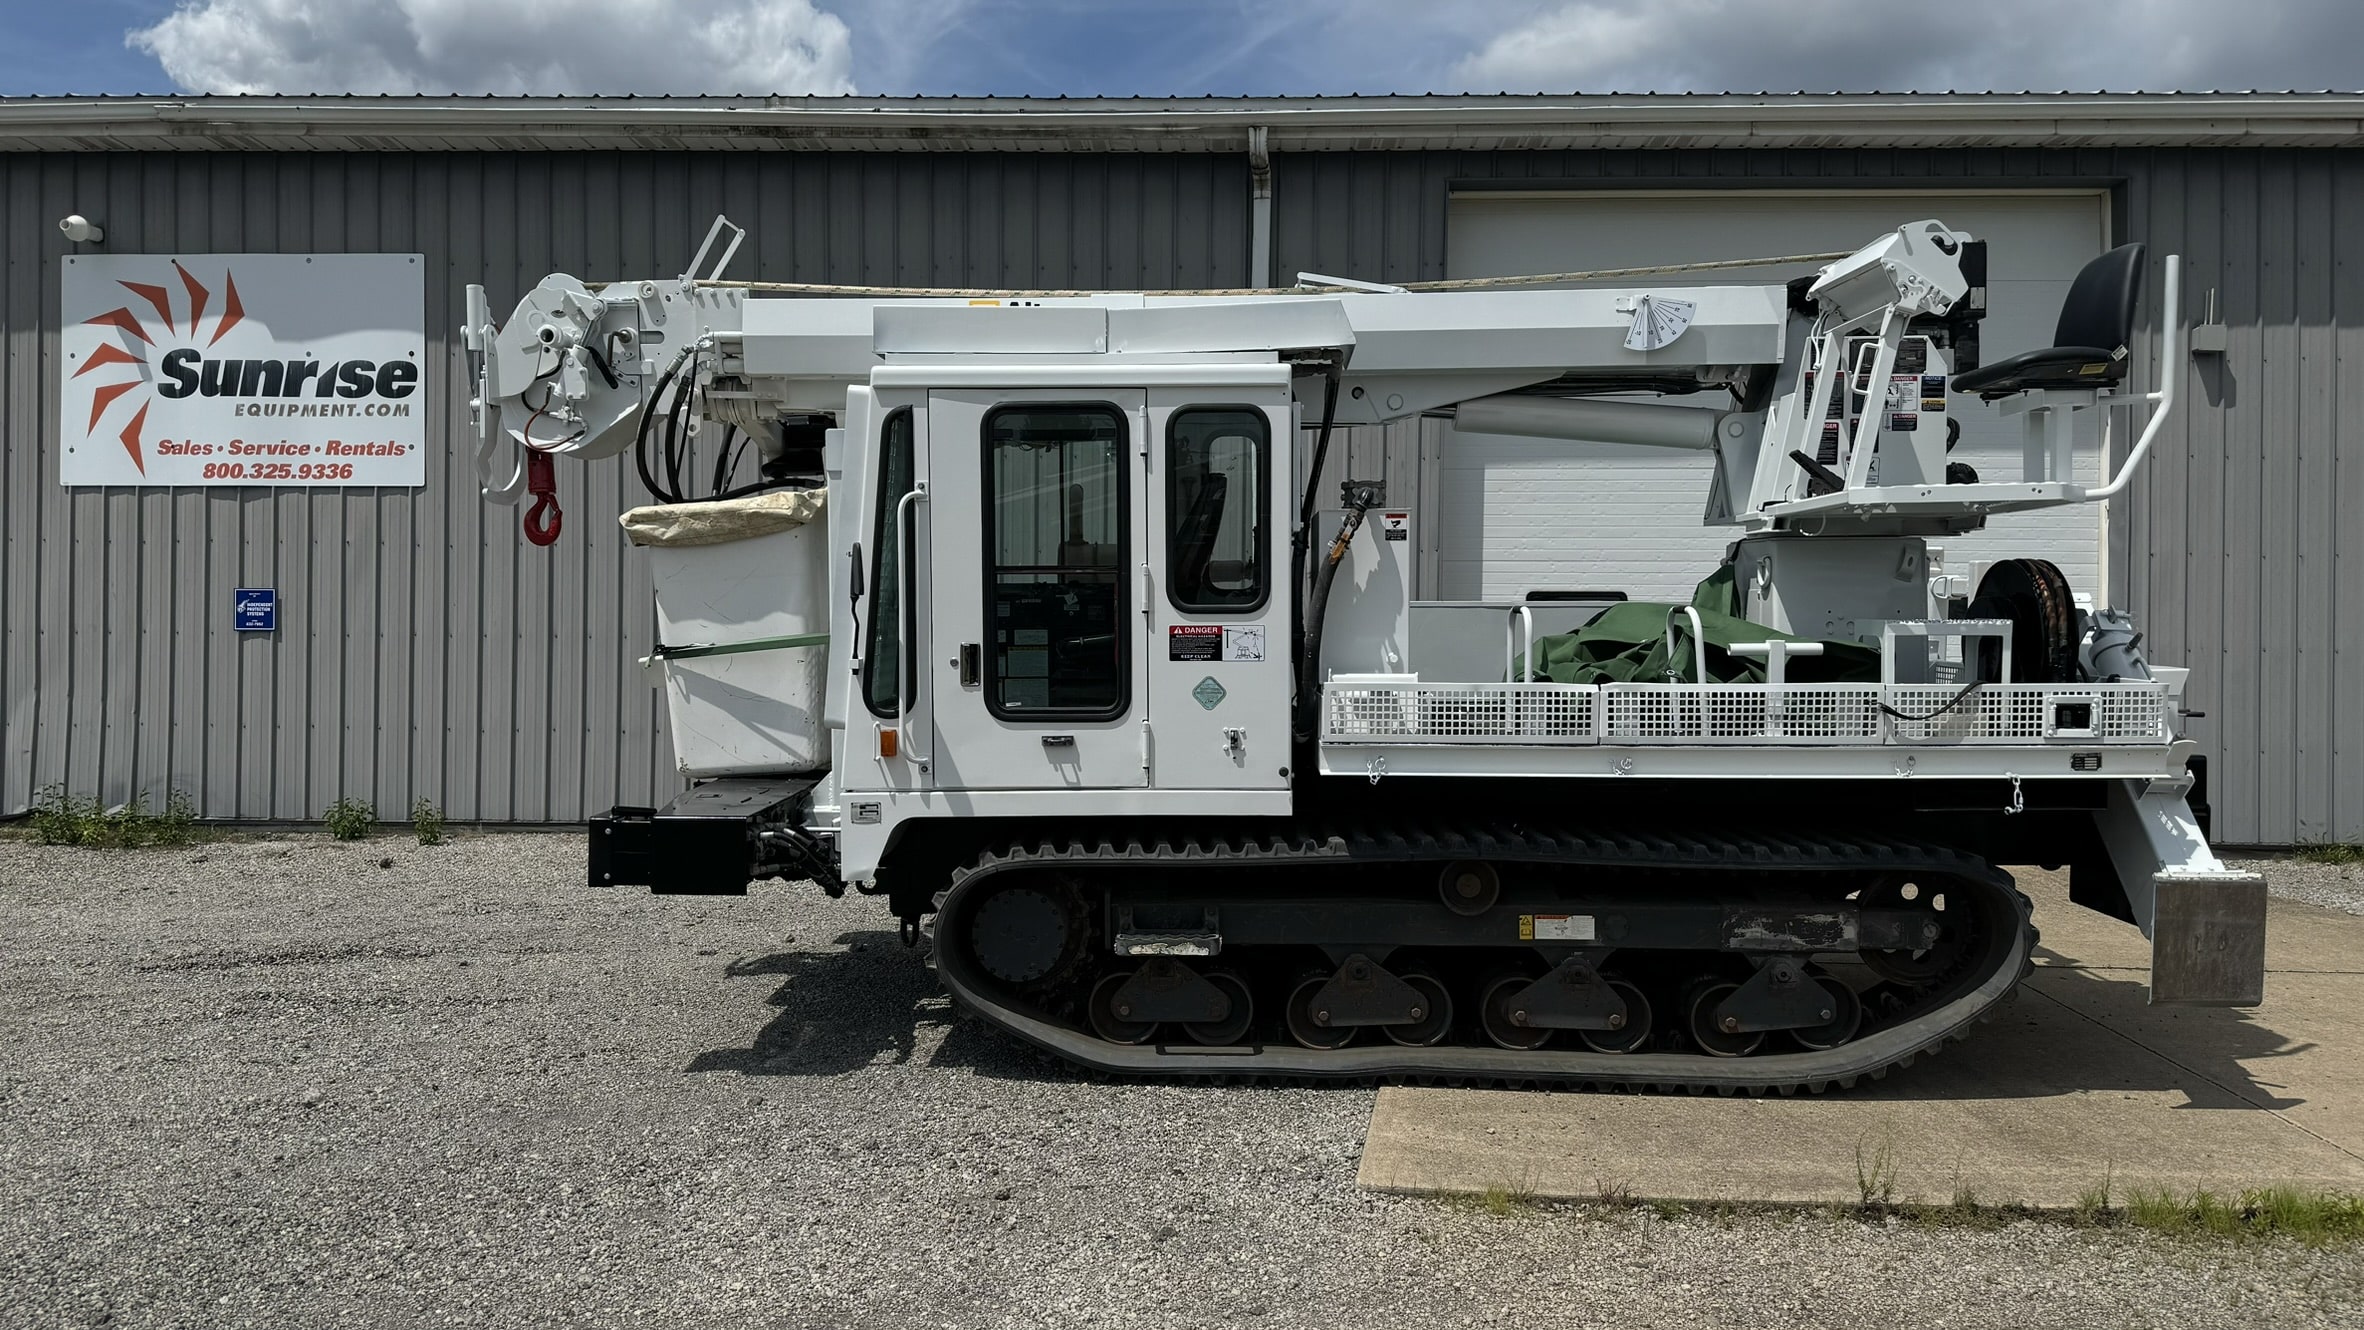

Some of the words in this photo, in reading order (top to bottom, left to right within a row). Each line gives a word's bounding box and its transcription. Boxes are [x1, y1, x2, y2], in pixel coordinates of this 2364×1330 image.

[157, 347, 418, 399] Sunrise
[234, 403, 411, 417] EQUIPMENT.COM
[157, 440, 213, 456] Sales
[228, 440, 310, 456] Service
[325, 440, 406, 456] Rentals
[202, 463, 353, 480] 800.325.9336
